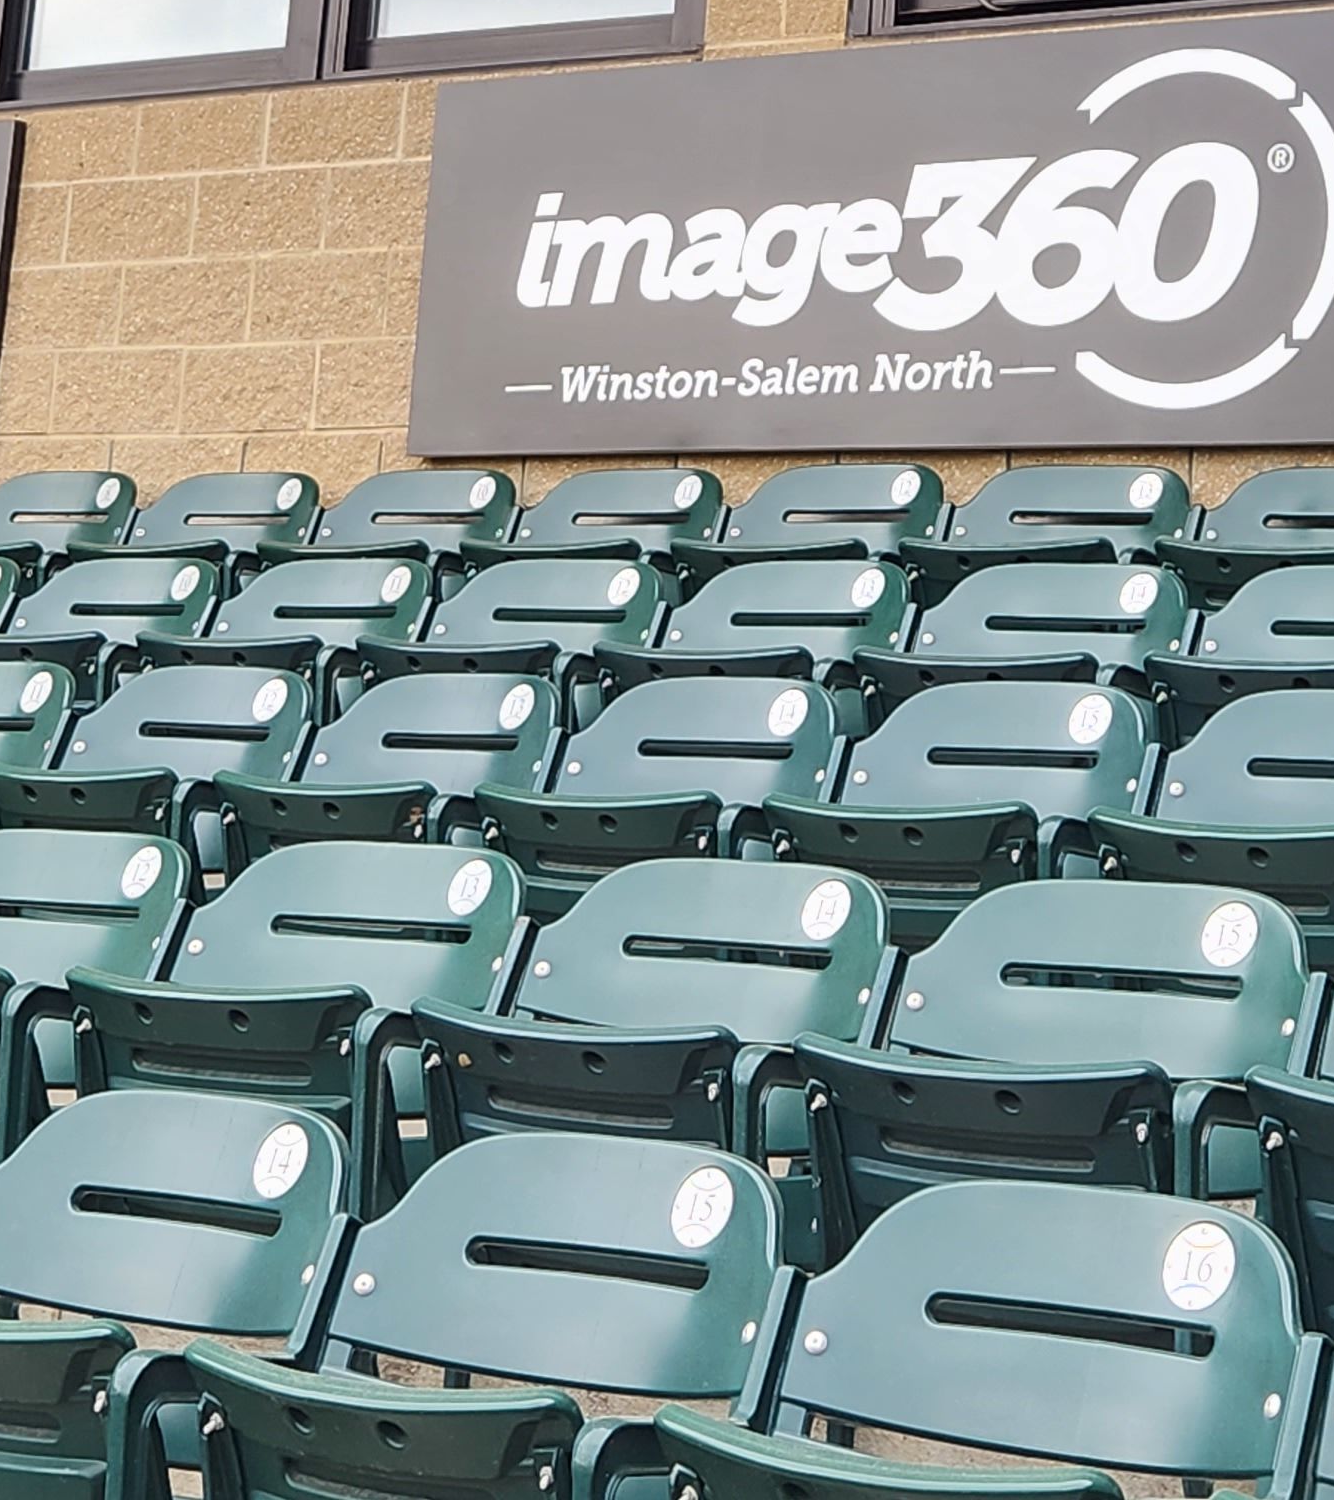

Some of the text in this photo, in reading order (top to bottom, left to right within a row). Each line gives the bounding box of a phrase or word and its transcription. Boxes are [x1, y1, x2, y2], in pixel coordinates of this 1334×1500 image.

[559, 349, 994, 405] Winston-Salem North
[262, 691, 277, 709] 12
[509, 698, 525, 716] 13
[779, 704, 796, 721] 14
[1081, 710, 1099, 729] 15
[131, 863, 151, 883] 12
[459, 876, 479, 898] 13
[815, 898, 836, 921] 14
[1217, 923, 1241, 947] 15
[266, 1147, 292, 1174] 14
[687, 1192, 714, 1222] 15
[1182, 1251, 1214, 1283] 16
